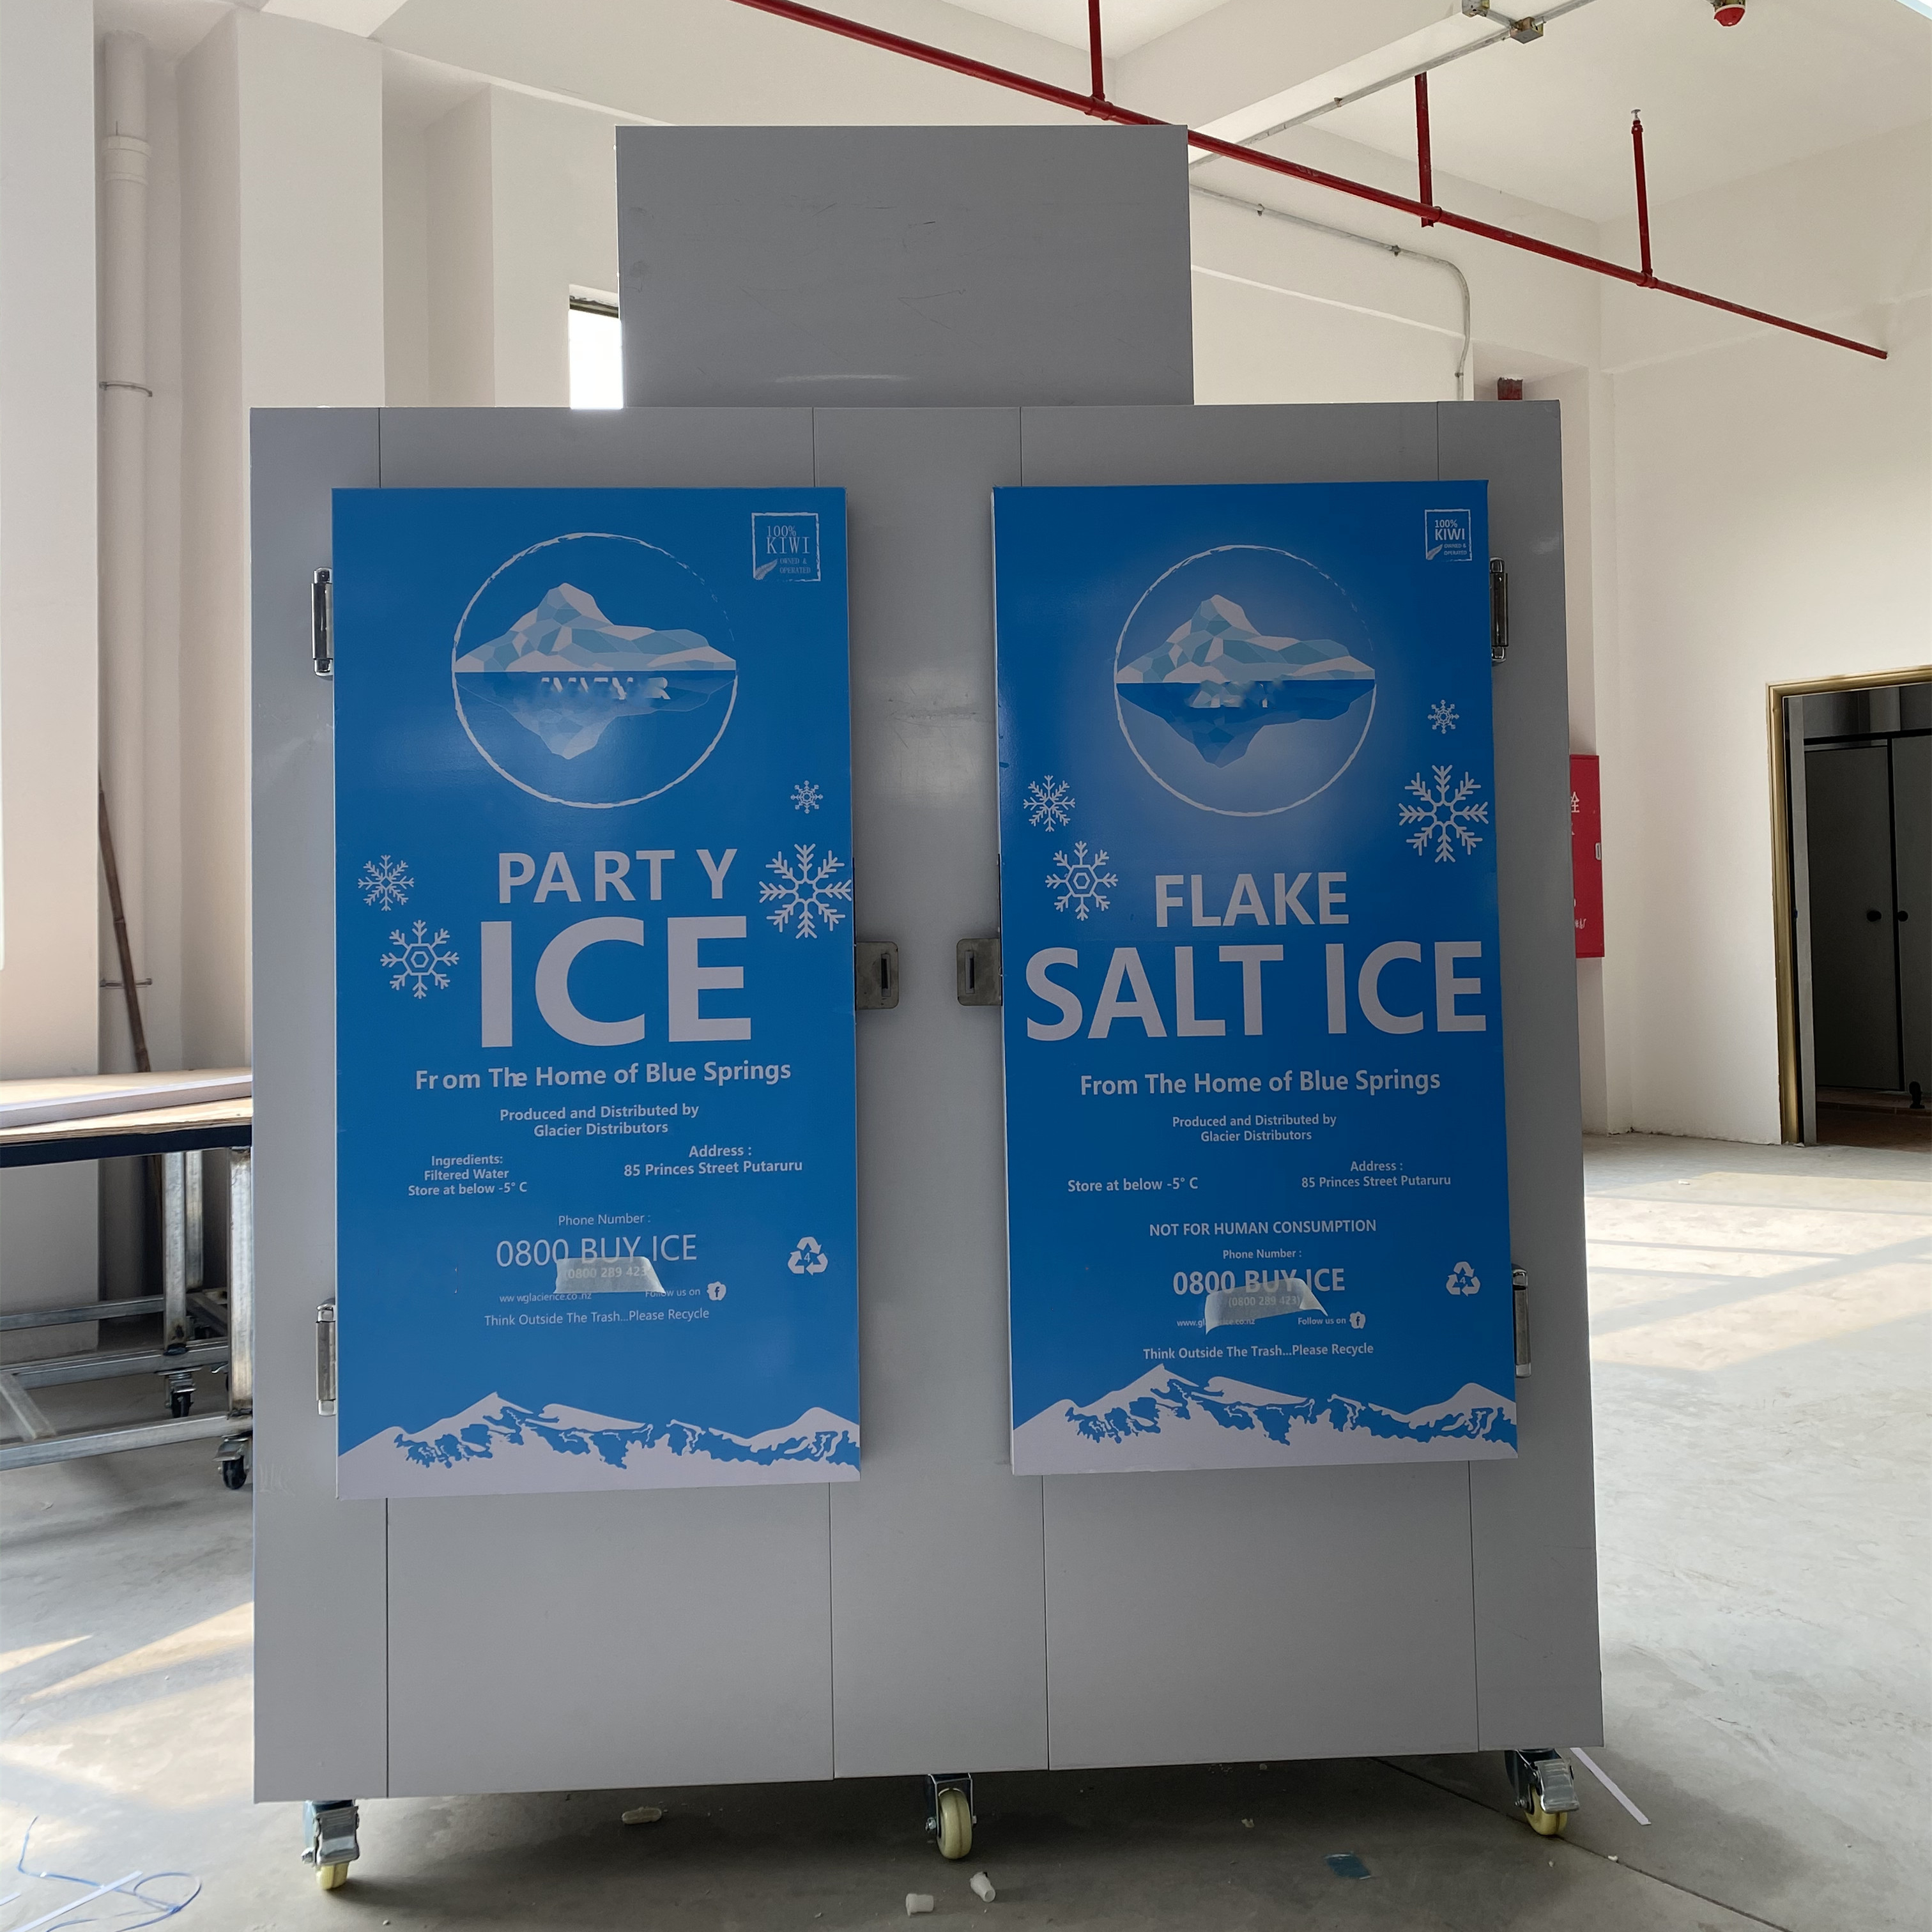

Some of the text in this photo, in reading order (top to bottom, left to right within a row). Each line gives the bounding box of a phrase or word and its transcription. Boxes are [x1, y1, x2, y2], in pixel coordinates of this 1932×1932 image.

[767, 525, 797, 537] 100%
[1435, 519, 1458, 528] 100%
[1435, 528, 1465, 540] KIWI
[766, 537, 810, 554] KIWI
[498, 848, 738, 904] PARTY
[1154, 871, 1349, 928] FLAKE
[480, 916, 751, 1048] ICE
[1025, 940, 1487, 1041] SALT ICE
[416, 1059, 791, 1090] From The Home of Blue Springs
[1081, 1068, 1441, 1096] From The Home of Blue Springs
[501, 1103, 700, 1121] Produced and Distributed by
[1172, 1113, 1337, 1128] Produced and Distributed by
[533, 1121, 669, 1137] Glacier Distributors
[1200, 1129, 1312, 1142] Glacier Distributors
[688, 1144, 744, 1158] Address
[431, 1154, 503, 1169] Ingredients:
[624, 1160, 802, 1177] 85 Princes Street Putaruru
[1350, 1160, 1397, 1172] Address
[424, 1169, 509, 1181] Filtered Water
[1301, 1175, 1451, 1188] 85 Princes Street Putaruru
[408, 1185, 439, 1197] Store
[443, 1184, 456, 1195] at
[458, 1183, 495, 1195] below
[519, 1181, 527, 1192] C
[1068, 1179, 1103, 1192] Store
[1106, 1179, 1119, 1191] at
[1123, 1177, 1163, 1191] below
[1189, 1177, 1199, 1190] C
[558, 1215, 594, 1226] Phone
[598, 1213, 645, 1225] Number
[1149, 1219, 1376, 1236] NOT FOR HUMAN CONSUMPTION
[495, 1234, 697, 1267] 0800 BUY ICE
[1223, 1249, 1254, 1259] Phone
[1257, 1248, 1296, 1259] Number
[601, 1266, 622, 1278] 289
[1173, 1268, 1345, 1294] 0800 BUY ICE
[1259, 1296, 1276, 1306] 289
[484, 1314, 516, 1326] Think
[518, 1312, 564, 1325] Outside
[566, 1312, 588, 1323] The
[668, 1307, 710, 1322] Recycle
[1298, 1317, 1323, 1325] Follow
[1142, 1347, 1176, 1360] Think
[1178, 1346, 1223, 1359] Outside
[1226, 1346, 1248, 1358] The
[1331, 1342, 1374, 1357] Recycle
